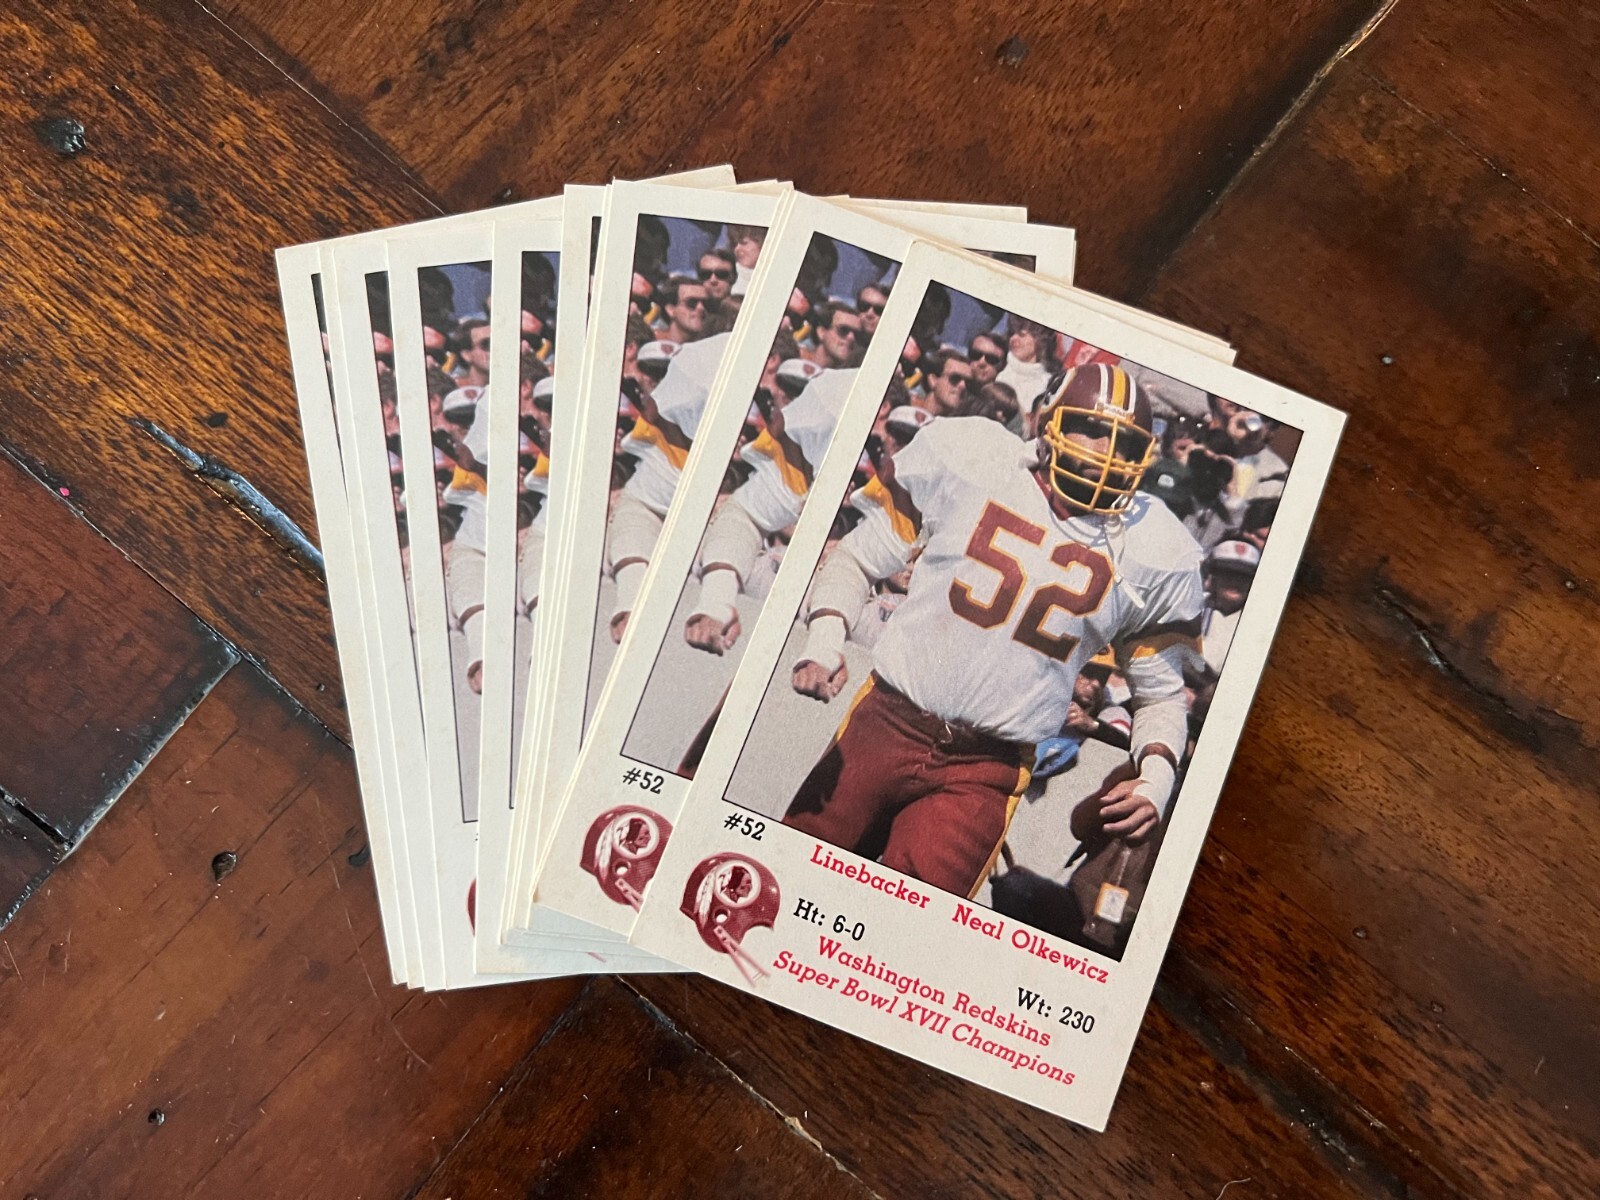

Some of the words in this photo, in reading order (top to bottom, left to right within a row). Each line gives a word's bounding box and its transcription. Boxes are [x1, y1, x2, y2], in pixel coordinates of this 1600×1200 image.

[948, 499, 1114, 664] 52
[622, 767, 665, 795] #52
[723, 812, 766, 841] #52
[793, 898, 826, 927] Ht:
[832, 914, 866, 942] 6-0
[809, 843, 931, 910] Linebacker
[951, 903, 1004, 941] Neal
[1010, 929, 1110, 985] Olkewicz
[773, 950, 840, 990] Super
[840, 976, 899, 1014] Bowl
[898, 1000, 949, 1035] XVII
[951, 1004, 1076, 1086] Champions
[818, 935, 946, 1006] Washington
[952, 991, 1052, 1047] Redskins
[1016, 986, 1052, 1019] Wt:
[1058, 1006, 1095, 1034] 230
